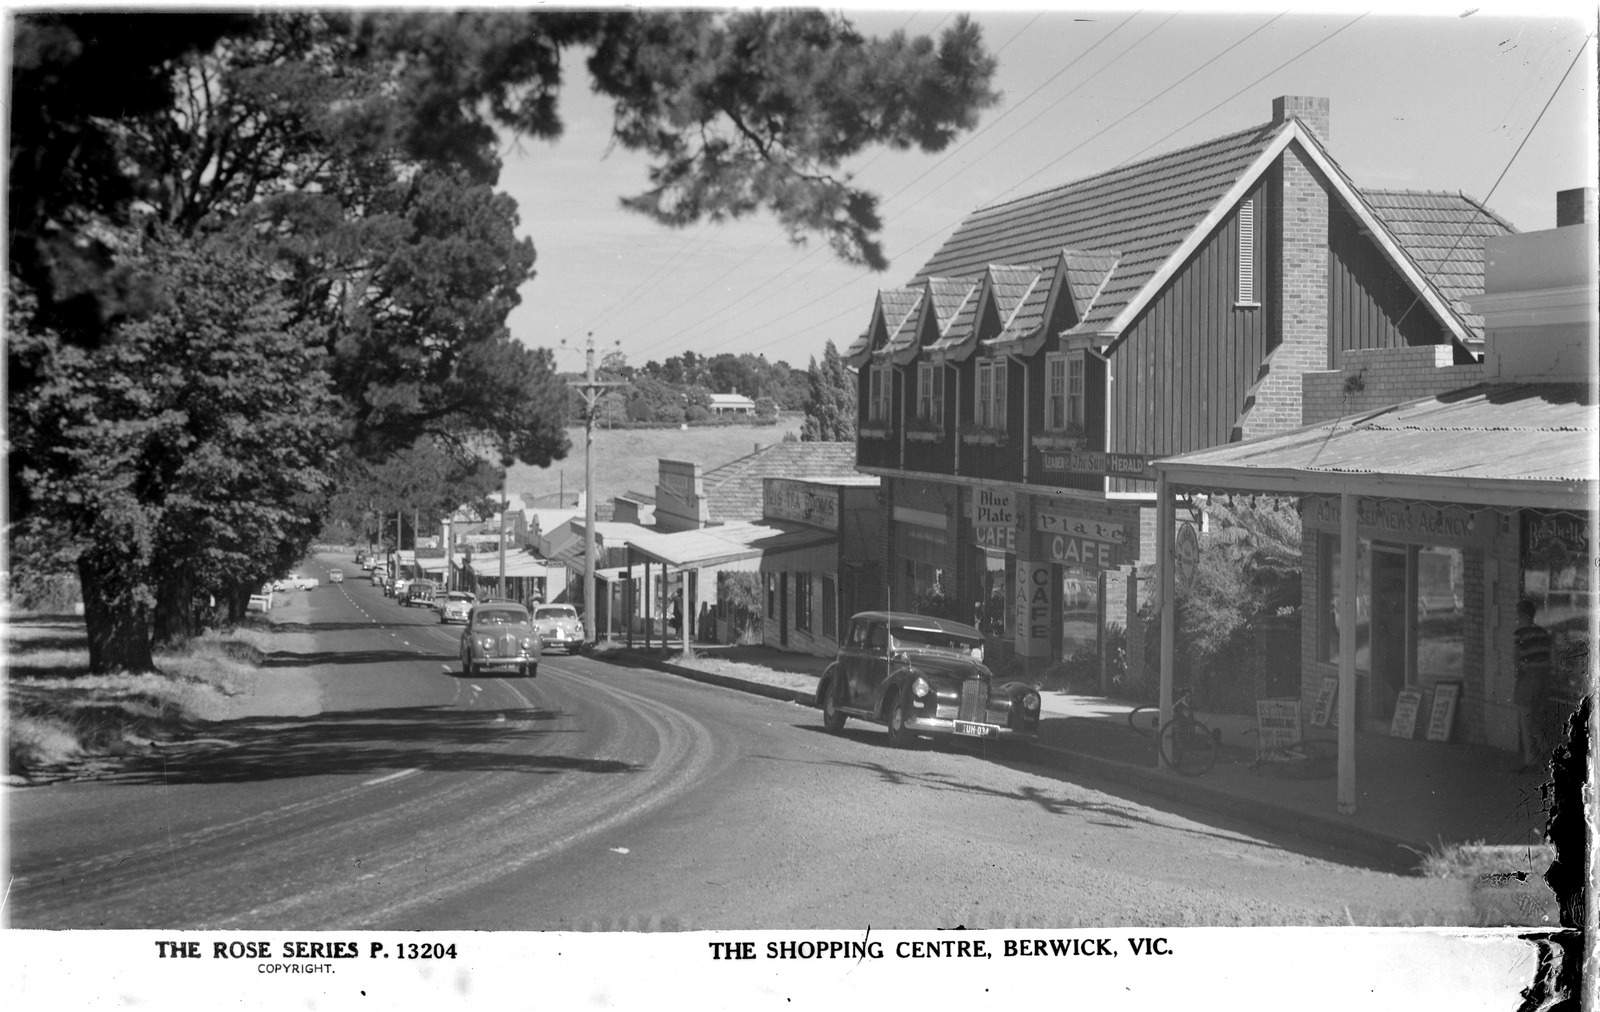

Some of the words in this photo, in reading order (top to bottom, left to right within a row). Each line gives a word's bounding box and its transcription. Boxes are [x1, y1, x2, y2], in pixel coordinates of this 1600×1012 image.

[1111, 453, 1143, 473] HERALD
[980, 491, 1008, 507] Blue
[978, 507, 1012, 522] Plate
[976, 528, 1016, 548] CAFE
[1041, 514, 1126, 540] Plate
[1052, 536, 1111, 567] CAFE
[1016, 567, 1027, 637] CAFE
[1031, 568, 1049, 639] CAFE
